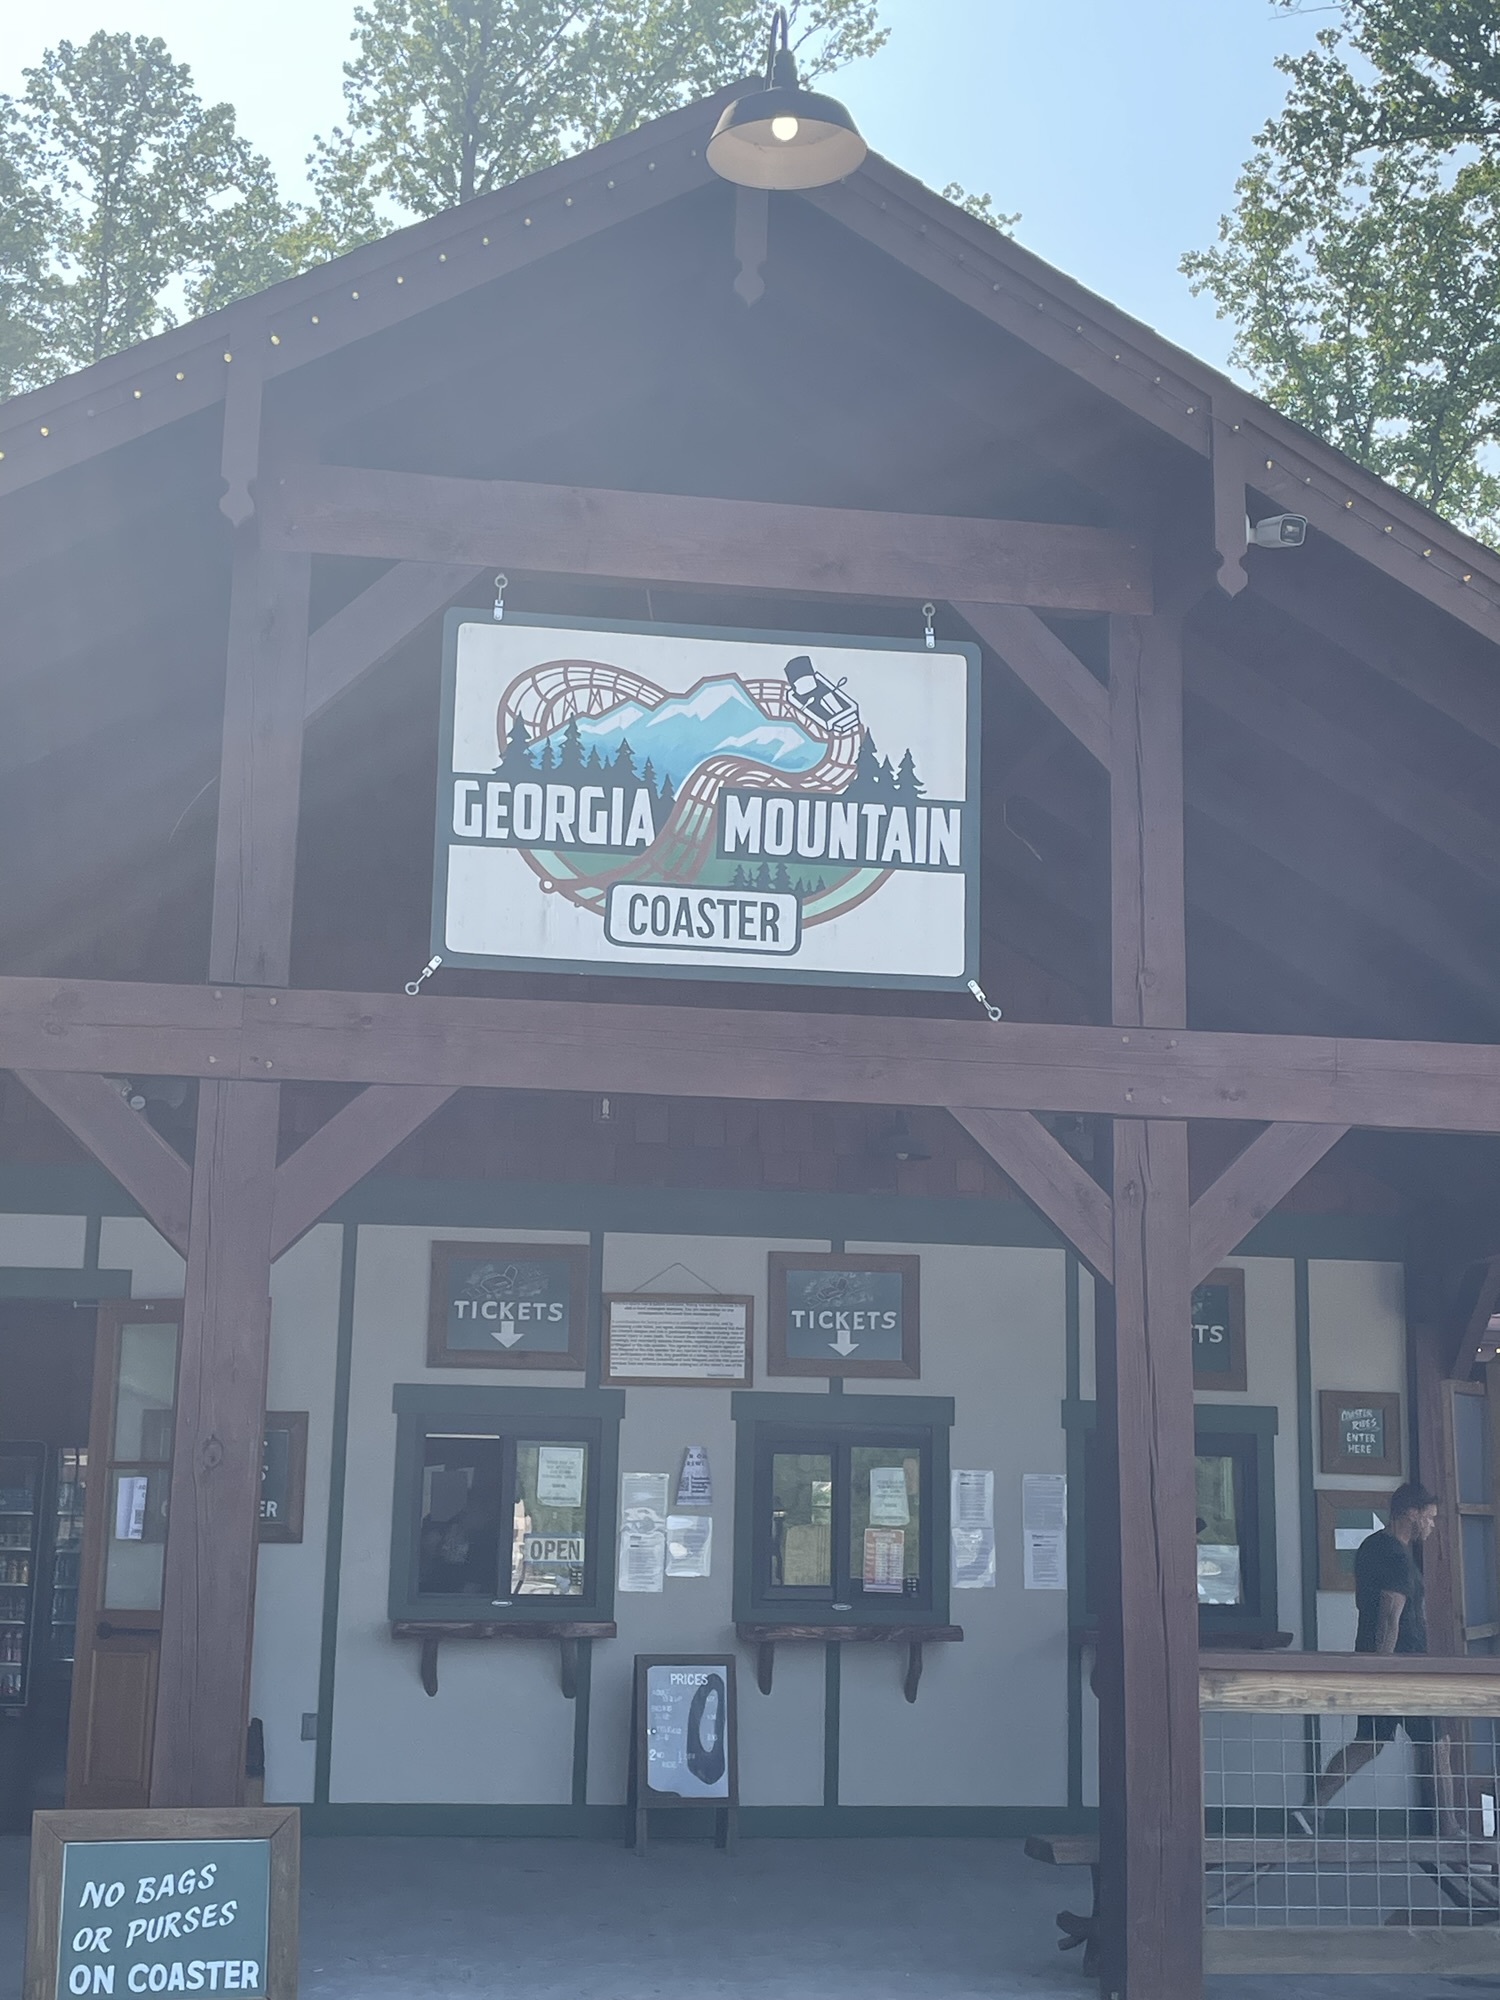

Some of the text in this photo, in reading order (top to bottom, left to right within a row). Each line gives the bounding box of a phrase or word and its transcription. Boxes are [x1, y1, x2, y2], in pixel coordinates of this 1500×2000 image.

[453, 780, 962, 867] GEORGIA MOUNTAIN
[628, 893, 780, 943] COASTER
[454, 1300, 564, 1322] TICKETS
[791, 1310, 898, 1330] TICKETS
[1346, 1432, 1376, 1443] ENTER
[1347, 1444, 1373, 1454] HERE
[530, 1540, 581, 1561] OPEN
[670, 1673, 709, 1686] PRICES
[79, 1863, 217, 1909] NO BAGS
[72, 1900, 238, 1953] OR PURSES
[69, 1960, 260, 1995] ON COASTER
